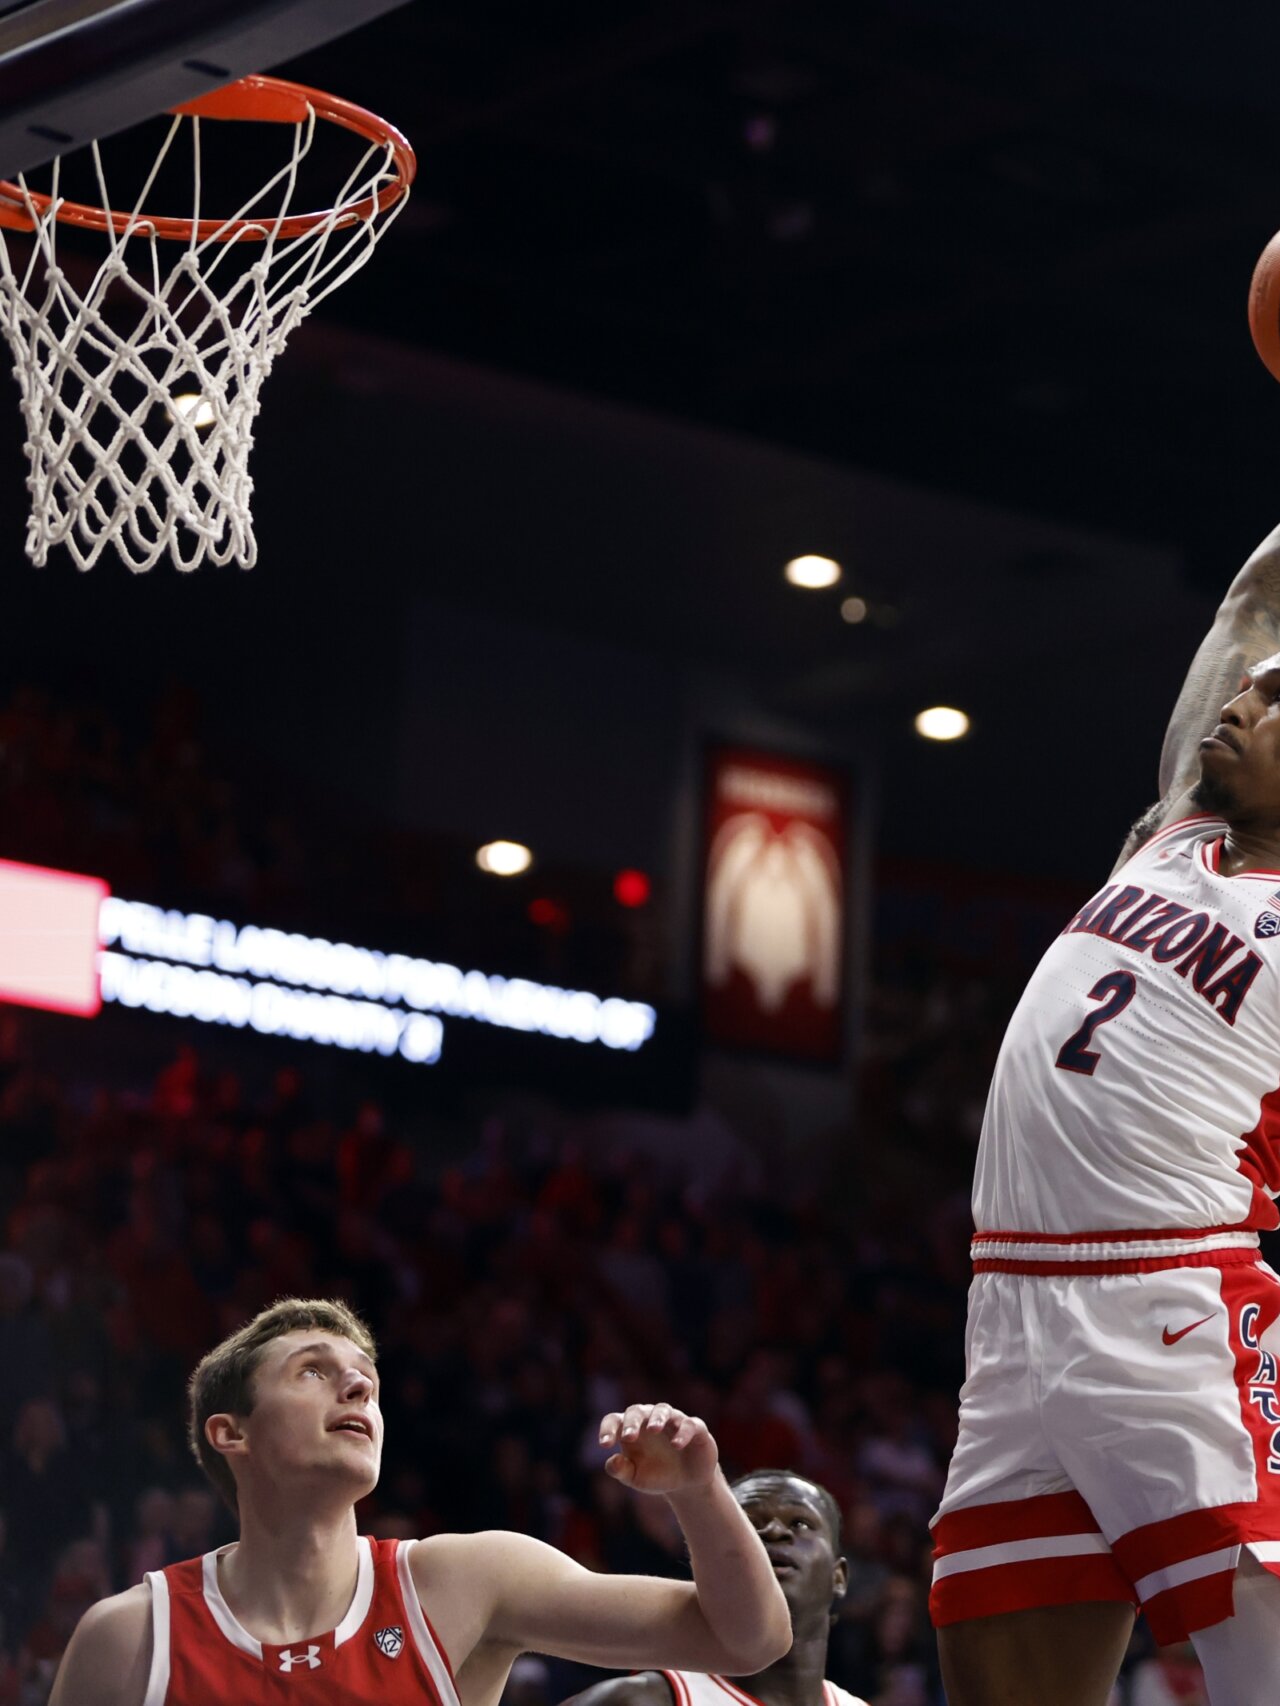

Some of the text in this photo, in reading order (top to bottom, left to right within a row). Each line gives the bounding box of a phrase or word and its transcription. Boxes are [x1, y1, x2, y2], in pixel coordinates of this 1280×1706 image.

[1061, 884, 1264, 1027] ARIZONA
[1055, 969, 1137, 1076] 2
[383, 1639, 399, 1653] 12
